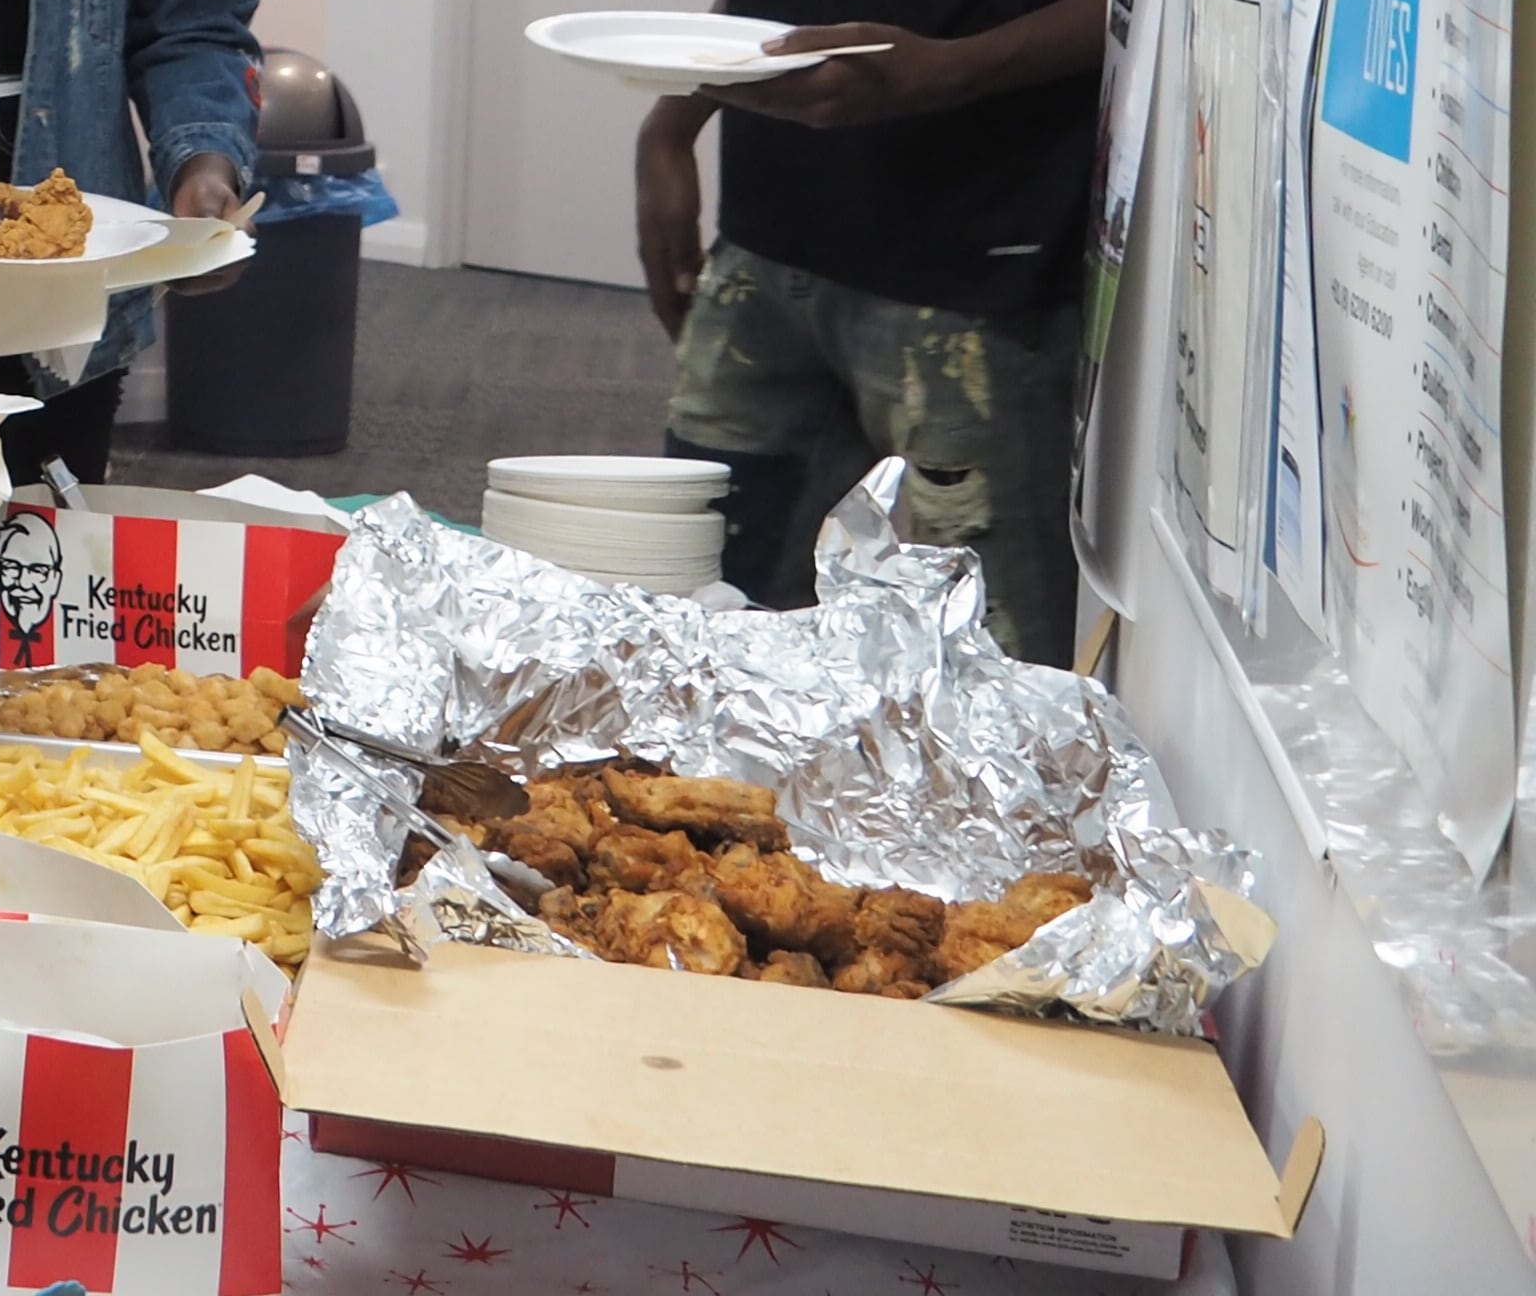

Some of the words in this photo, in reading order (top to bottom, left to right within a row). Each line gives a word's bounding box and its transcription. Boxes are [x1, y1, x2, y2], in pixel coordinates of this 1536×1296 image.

[88, 574, 207, 624] Kentucky
[61, 603, 126, 642] Fried
[133, 614, 236, 653] Chicken
[47, 1184, 218, 1237] Chicken
